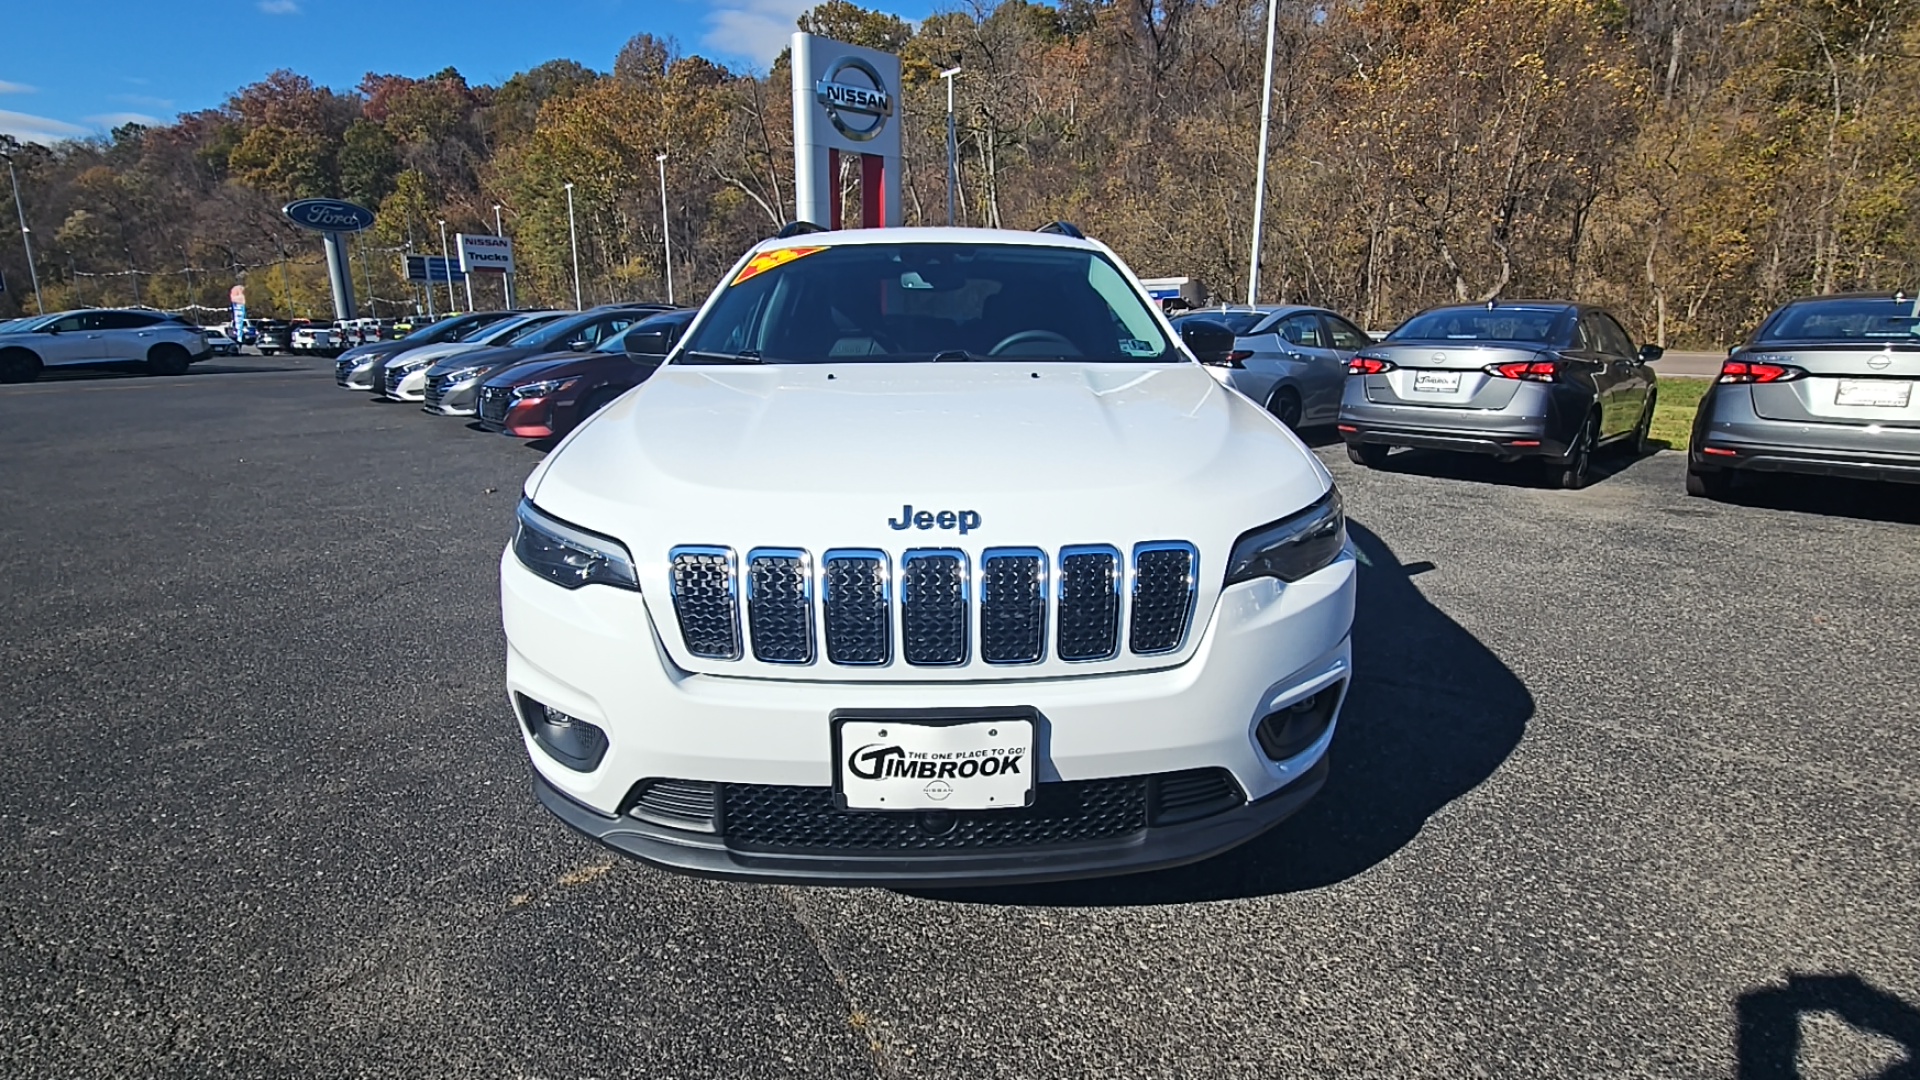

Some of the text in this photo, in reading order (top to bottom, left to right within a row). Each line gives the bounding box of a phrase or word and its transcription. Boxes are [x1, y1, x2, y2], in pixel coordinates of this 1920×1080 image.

[826, 85, 889, 111] NISSAN
[306, 204, 358, 225] Ford
[465, 237, 508, 248] NISSAN
[467, 251, 509, 262] Trucks
[888, 504, 982, 536] Jeep
[848, 743, 1023, 781] TIMBROOK
[908, 746, 1026, 760] THE ONE PLACE TO GO!
